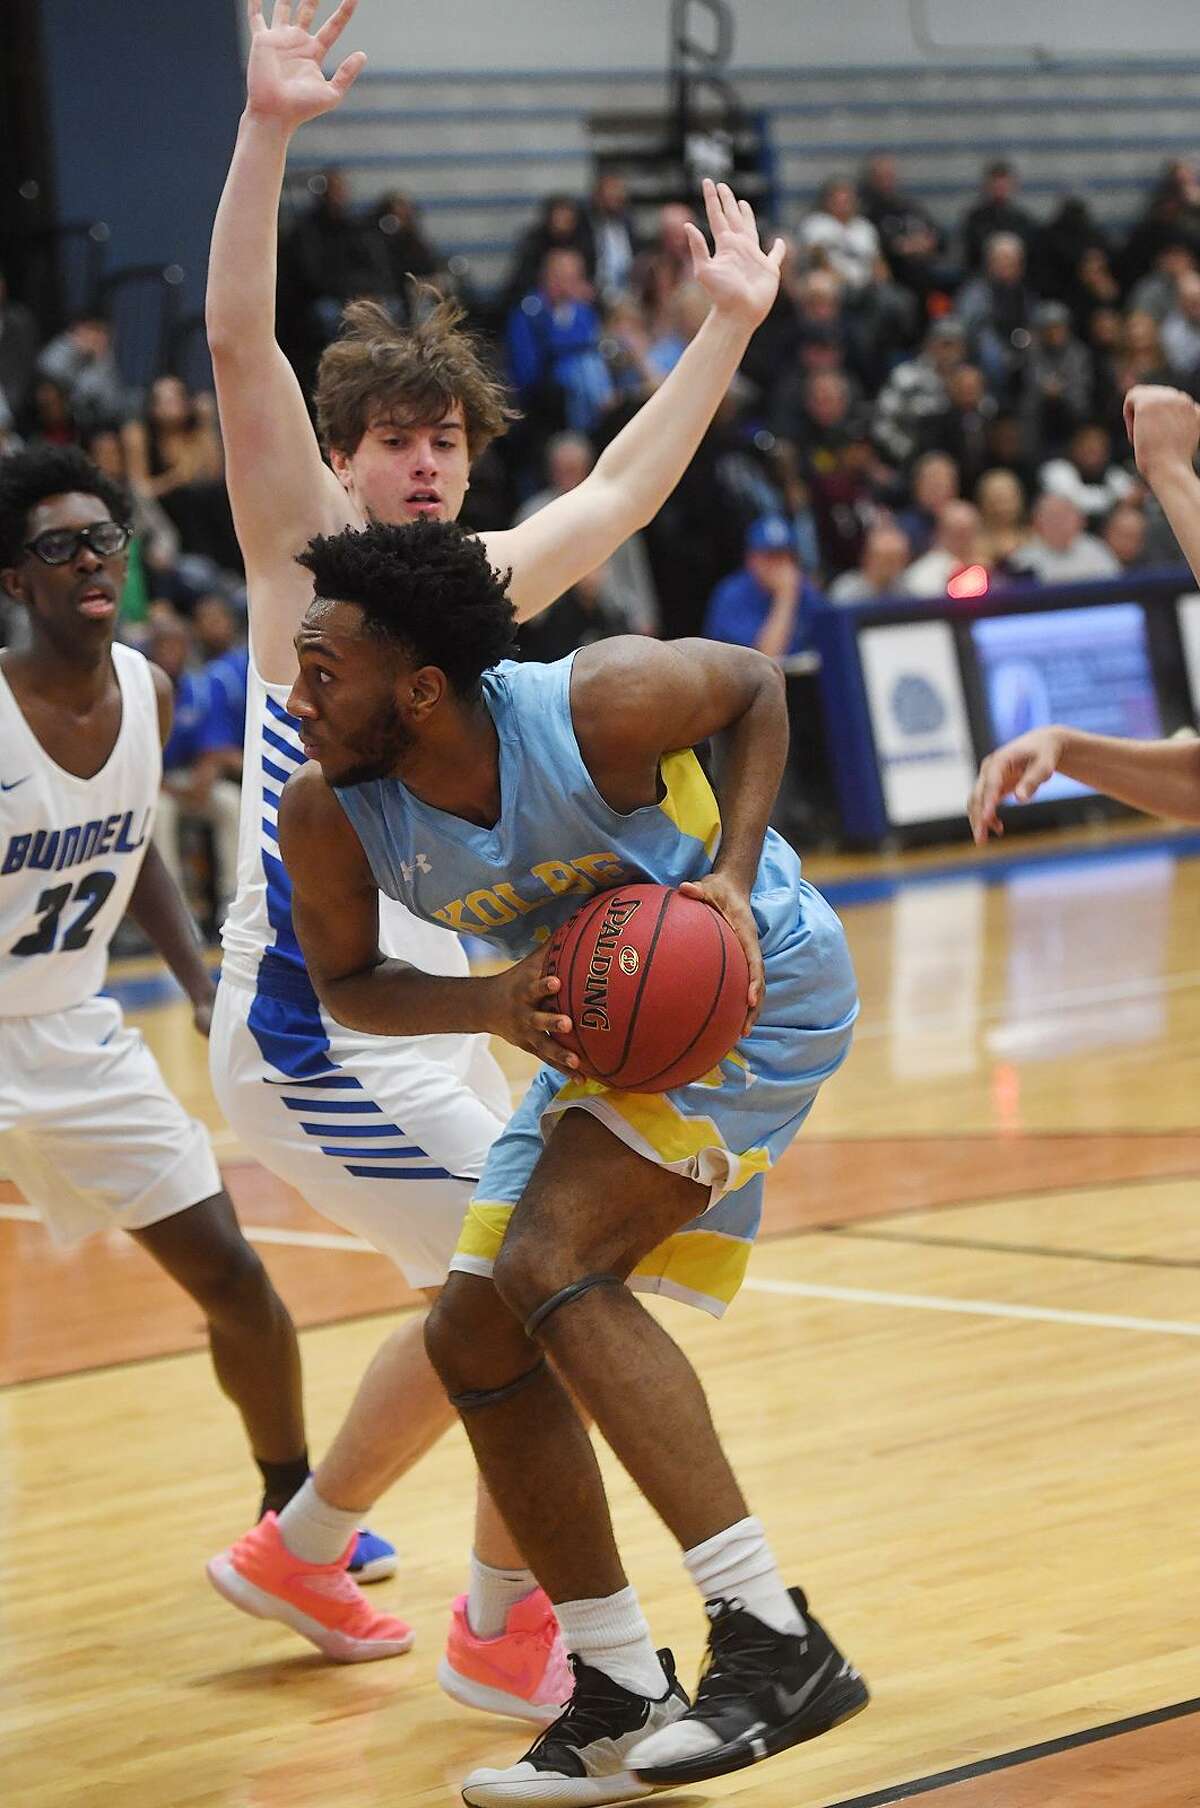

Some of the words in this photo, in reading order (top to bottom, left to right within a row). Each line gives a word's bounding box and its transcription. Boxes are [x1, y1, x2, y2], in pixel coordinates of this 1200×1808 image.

[1, 808, 150, 875] BUNNEL
[10, 871, 117, 957] 32
[580, 897, 643, 1032] SPALDING
